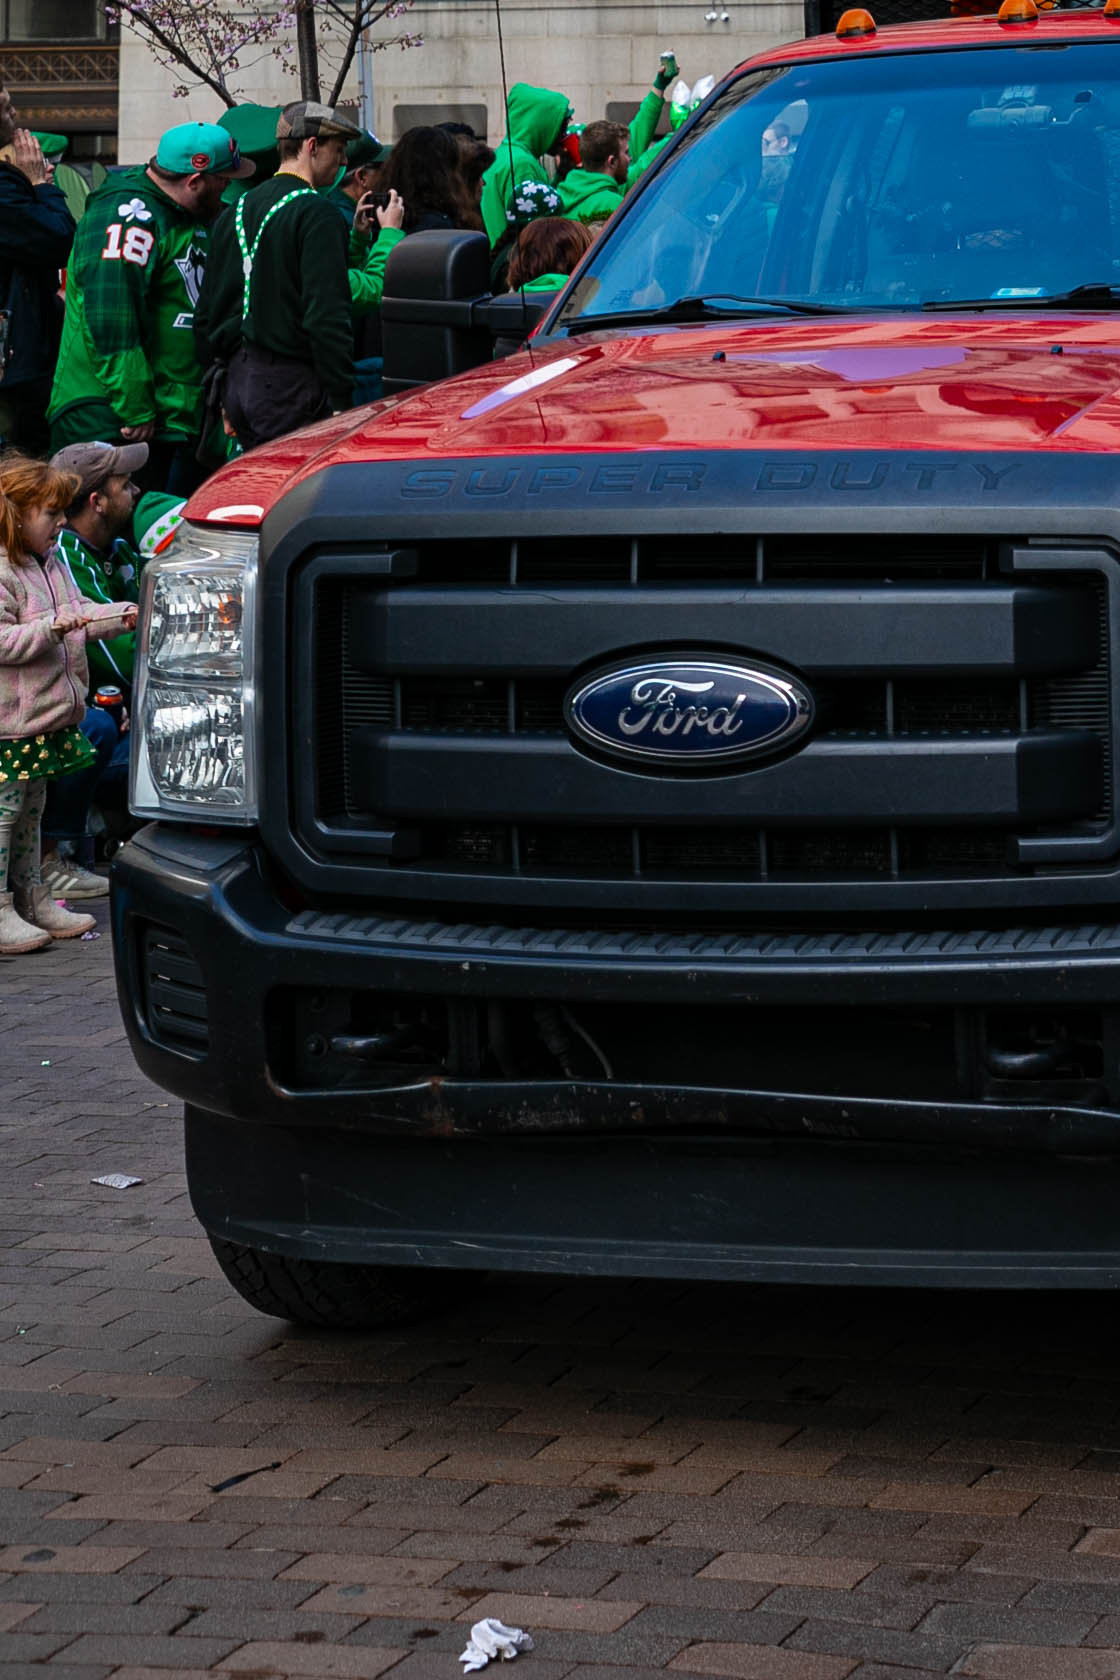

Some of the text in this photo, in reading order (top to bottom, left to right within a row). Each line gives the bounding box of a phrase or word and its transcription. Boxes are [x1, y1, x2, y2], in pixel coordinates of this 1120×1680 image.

[101, 223, 155, 268] 18
[400, 462, 1022, 499] SUPER DUTY
[618, 678, 745, 736] Ford
